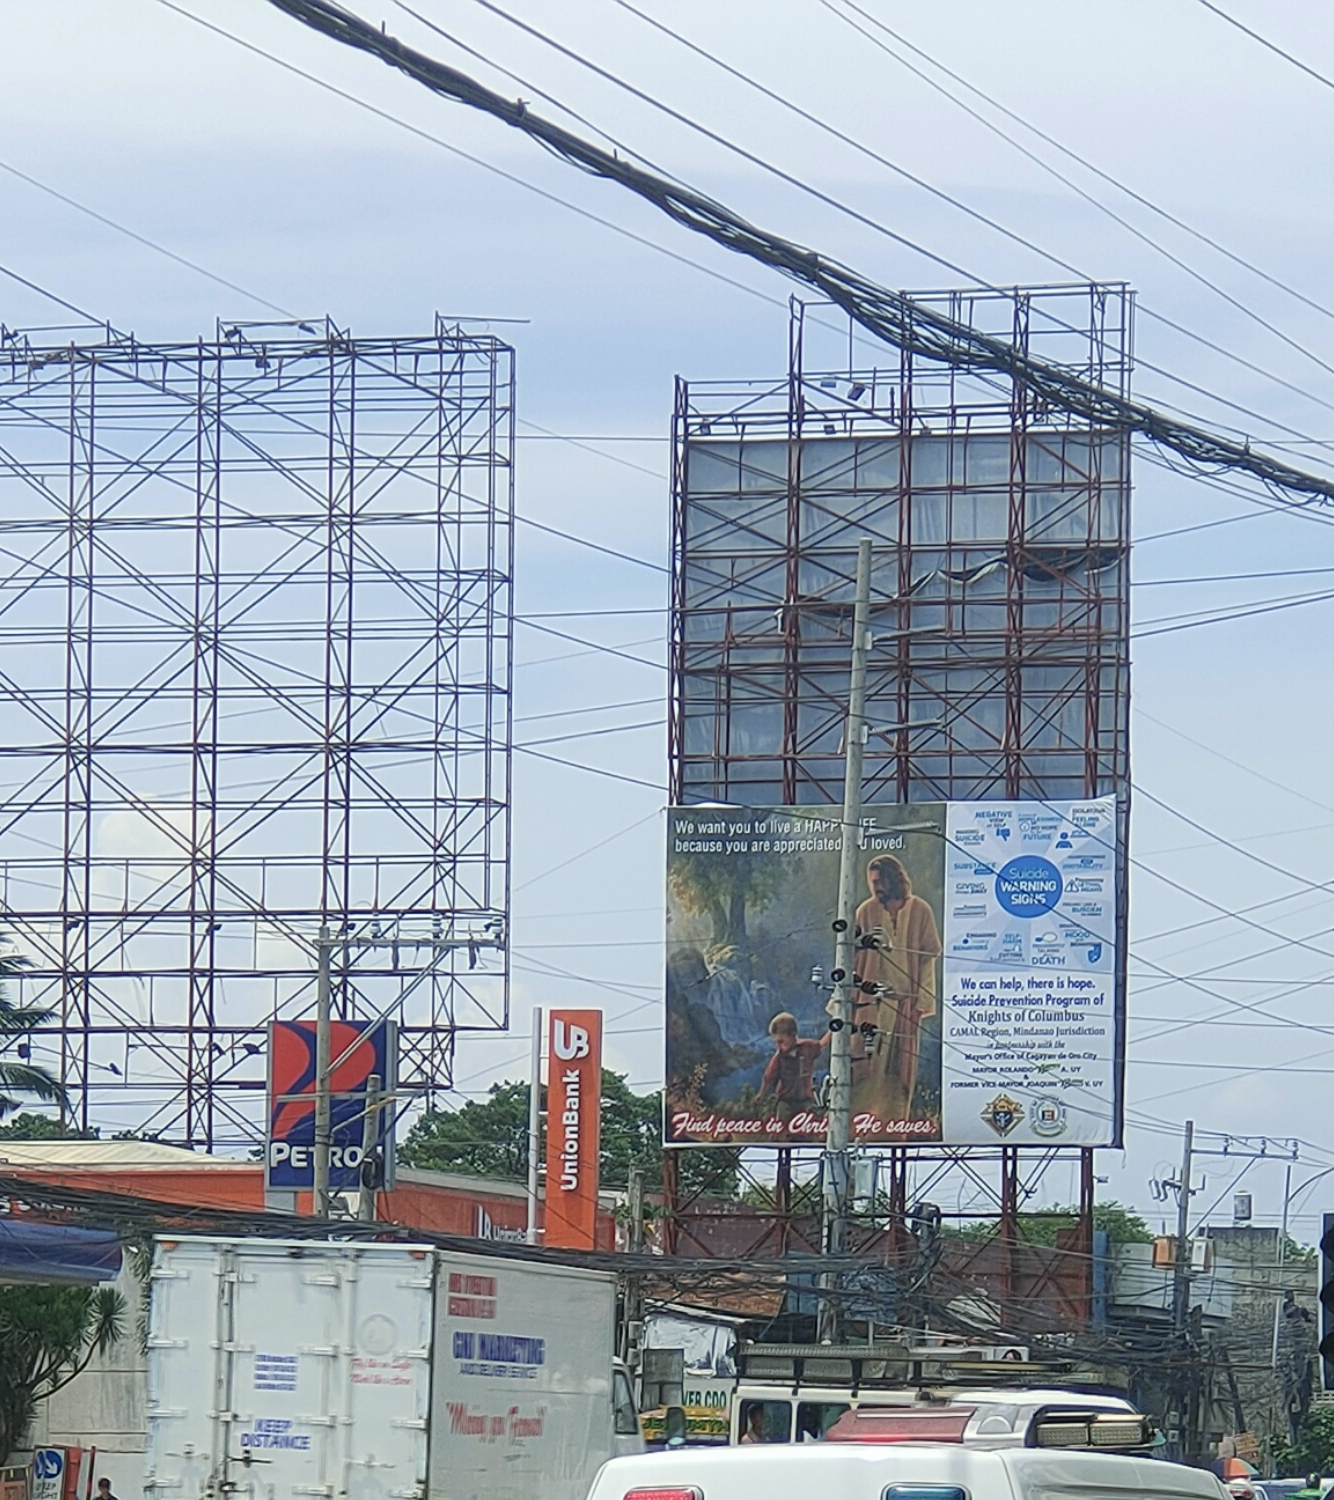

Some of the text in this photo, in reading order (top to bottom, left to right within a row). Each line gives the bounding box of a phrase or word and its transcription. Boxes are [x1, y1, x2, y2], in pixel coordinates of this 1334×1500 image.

[674, 819, 695, 834] We
[697, 820, 726, 835] want
[728, 821, 751, 838] you
[754, 819, 767, 834] to
[769, 818, 791, 834] live
[793, 821, 802, 833] a
[674, 838, 723, 853] because
[725, 839, 748, 855] you
[751, 839, 771, 852] are
[773, 837, 842, 854] appreciated
[870, 835, 907, 850] loved.
[1009, 867, 1050, 879] Suicide
[999, 880, 1058, 893] WARNING
[1011, 893, 1047, 905] SIGNS
[1031, 956, 1066, 966] DEATH
[960, 975, 1096, 991] We can help, there is hope.
[951, 992, 1105, 1009] Suicide Prevention Program of
[967, 1009, 1085, 1026] Knights of Columbus
[949, 1026, 1106, 1039] CAMAL Region, Mindanao Jurisdiction
[994, 1052, 1014, 1060] Office
[1083, 1052, 1097, 1061] City
[560, 1068, 580, 1192] UnionBank
[672, 1112, 712, 1138] Find
[713, 1118, 762, 1138] peace
[765, 1116, 784, 1133] in
[787, 1113, 830, 1135] Chri
[853, 1113, 882, 1135] He
[240, 1433, 311, 1450] DISTANCE
